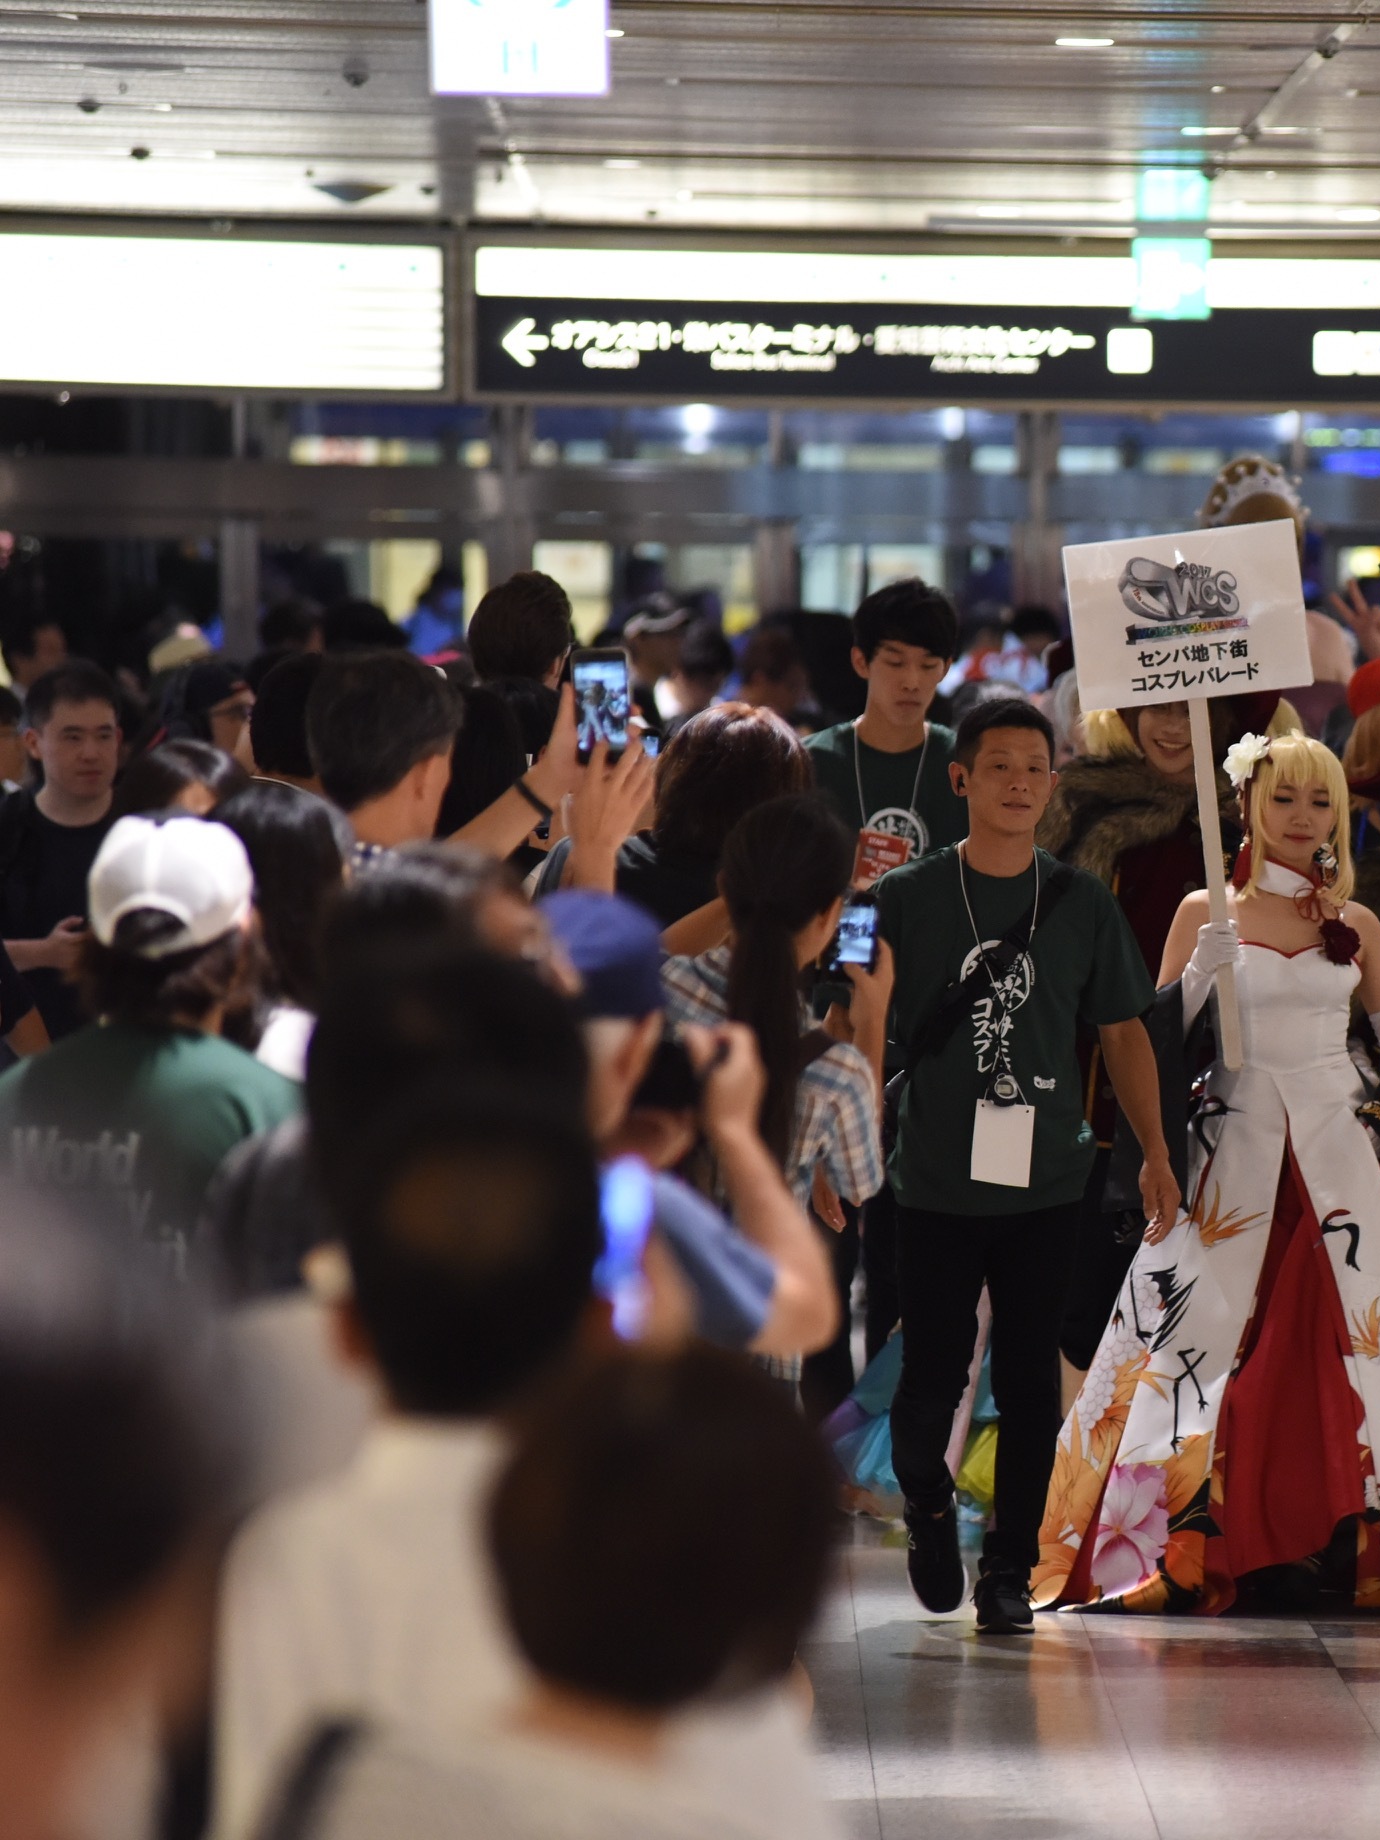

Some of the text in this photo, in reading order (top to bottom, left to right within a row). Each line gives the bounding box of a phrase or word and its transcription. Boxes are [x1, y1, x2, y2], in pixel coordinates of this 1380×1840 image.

[1177, 562, 1212, 578] 2017
[1164, 570, 1240, 619] WCS
[1137, 639, 1249, 669] センパ地下街
[1131, 662, 1260, 693] コスプレパレード
